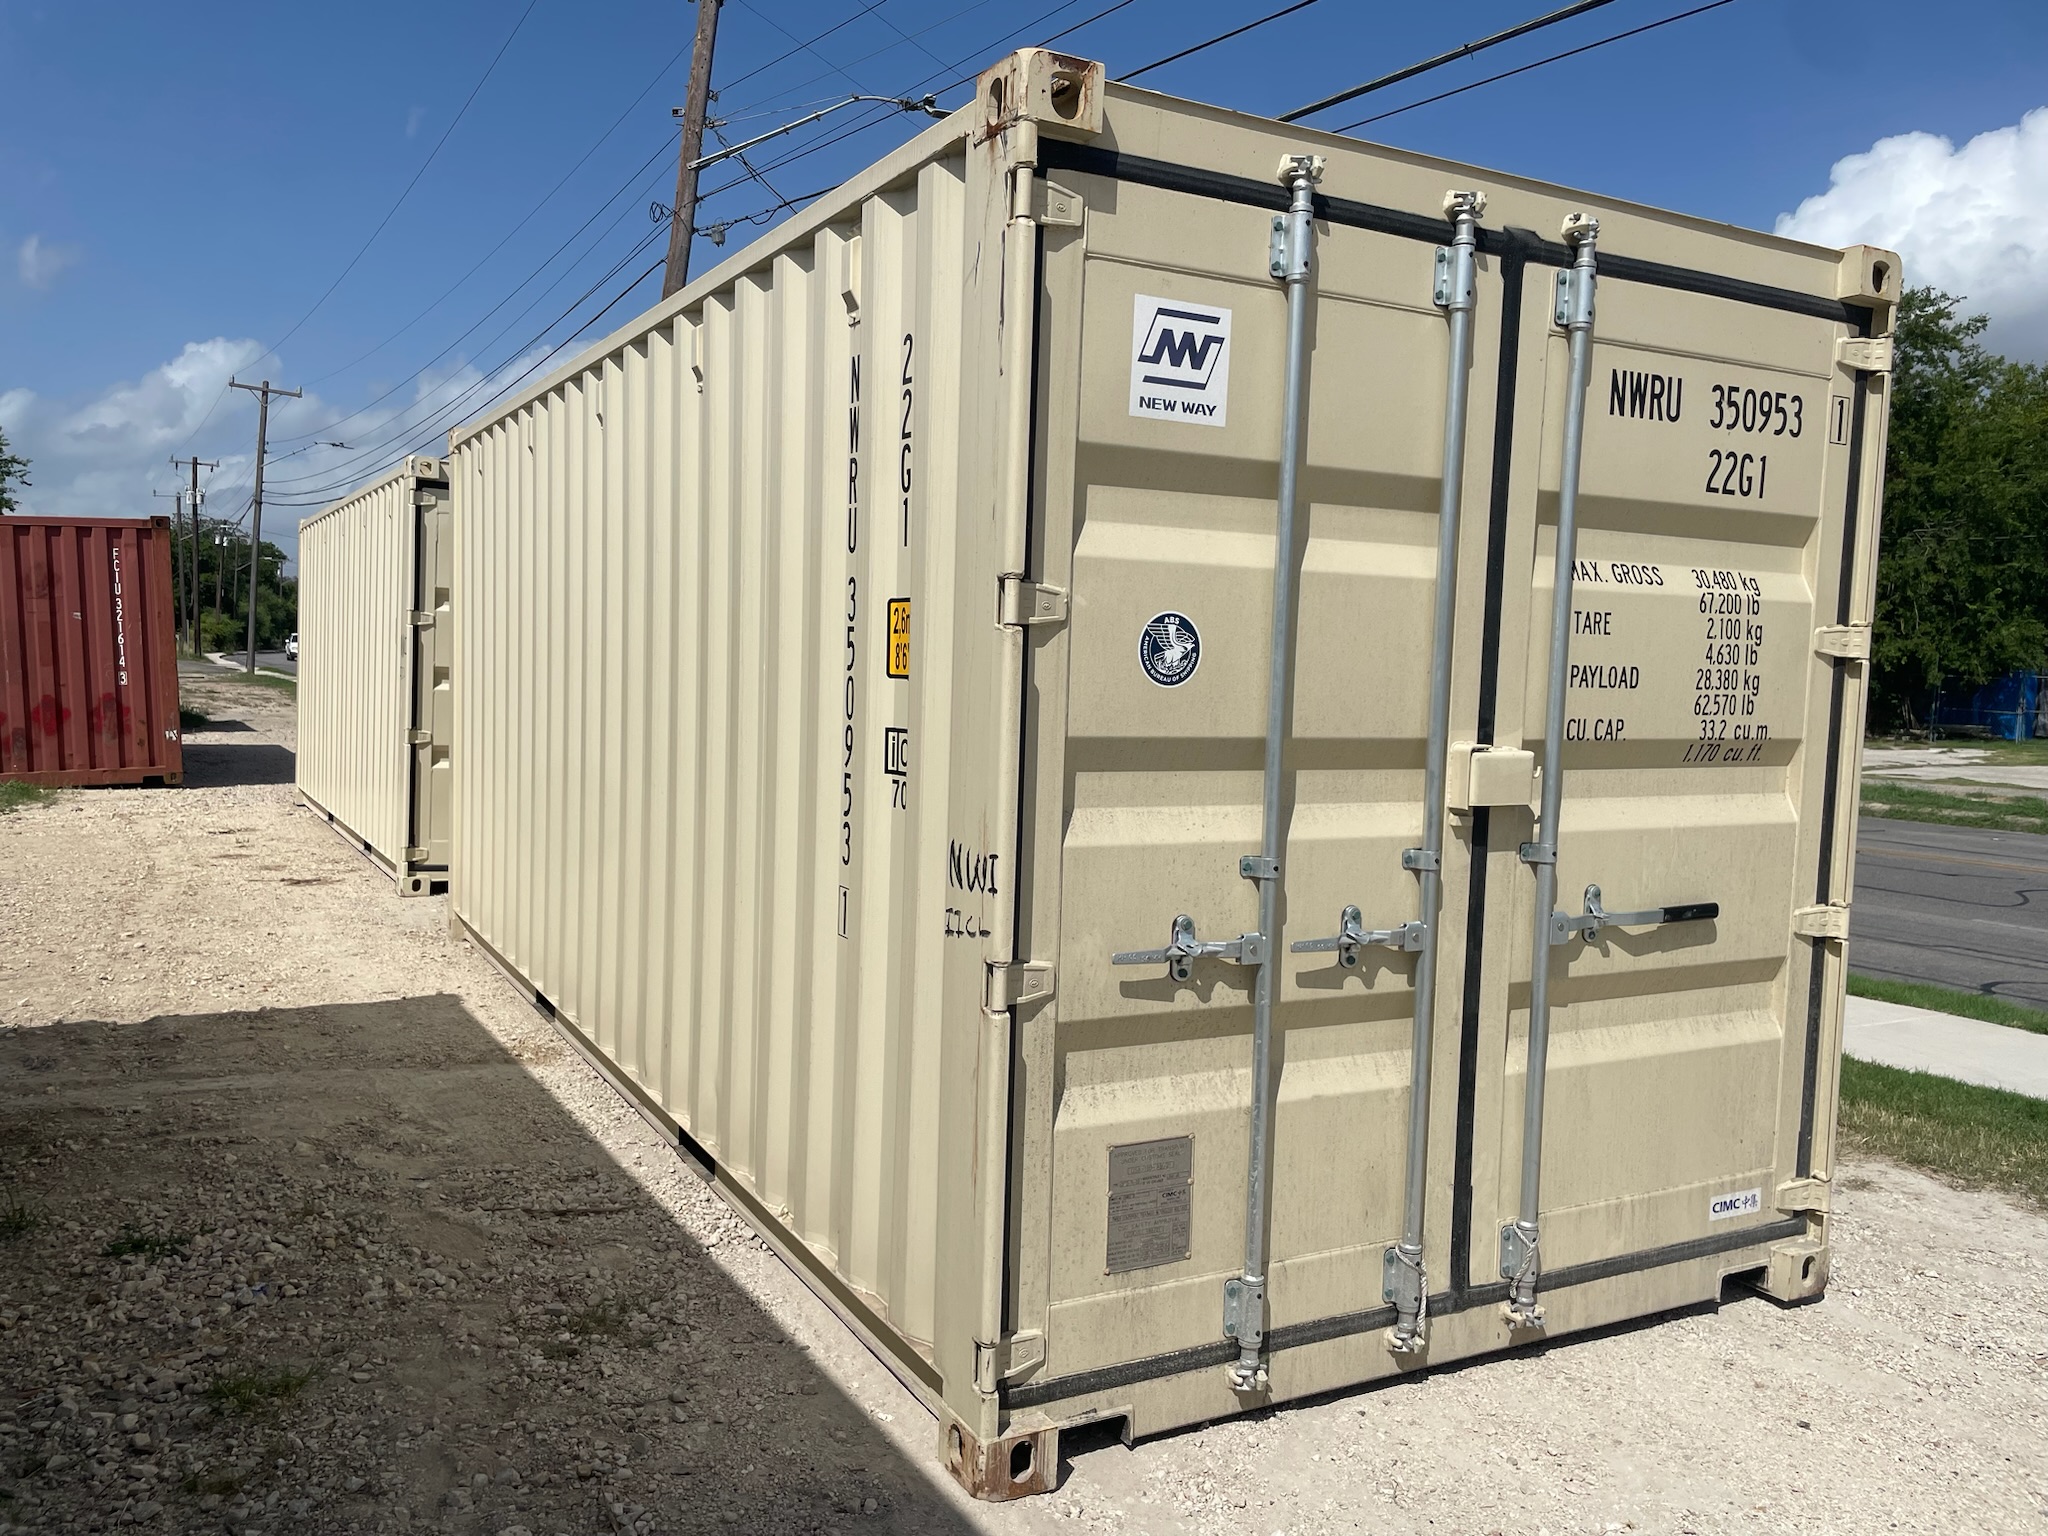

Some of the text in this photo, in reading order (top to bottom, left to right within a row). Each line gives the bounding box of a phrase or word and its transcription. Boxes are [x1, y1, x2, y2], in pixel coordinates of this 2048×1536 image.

[1139, 395, 1217, 417] NEW WAY
[1609, 368, 1683, 423] NWRU
[1709, 384, 1804, 438] 350953
[848, 354, 860, 554] NWRU
[900, 333, 913, 548] 22G1
[1705, 449, 1767, 499] 22G1
[112, 547, 122, 595] FCIU
[1611, 563, 1664, 586] GROSS
[1738, 572, 1761, 597] kg
[1164, 616, 1180, 625] ABS
[1747, 594, 1760, 616] lb
[115, 597, 126, 668] 321614
[1574, 611, 1612, 635] TARE
[1746, 619, 1763, 647] kg
[1142, 635, 1152, 670] AMERICAN
[1150, 669, 1172, 683] BUREAU
[1745, 644, 1758, 666] lb
[1569, 665, 1640, 689] PAYLOAD
[1743, 670, 1760, 696] kg
[842, 576, 856, 866] 350953
[1741, 695, 1754, 716] lb
[1699, 719, 1727, 741] 33.2
[1712, 1198, 1740, 1213] CIMC
